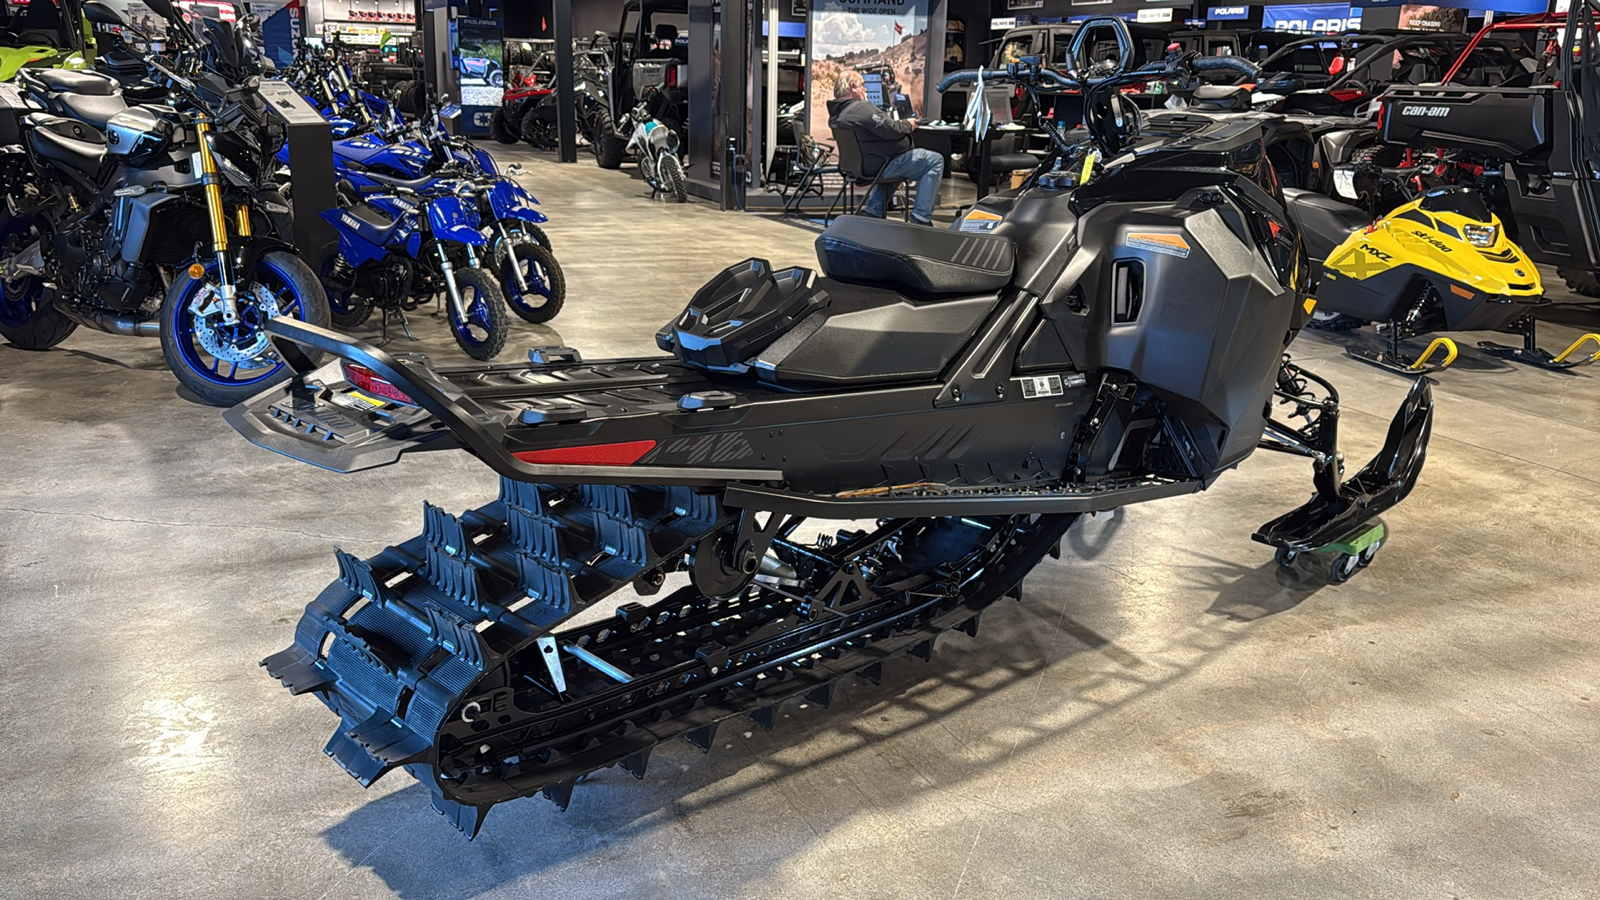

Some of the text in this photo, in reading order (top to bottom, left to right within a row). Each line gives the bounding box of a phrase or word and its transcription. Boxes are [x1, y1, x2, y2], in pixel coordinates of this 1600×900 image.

[1215, 7, 1245, 15] POLARIS
[1274, 18, 1362, 35] POLARIS
[1402, 105, 1450, 117] can-am
[340, 213, 361, 231] YAMAHA
[1411, 230, 1453, 253] ski-doo
[1360, 243, 1394, 262] MXZ
